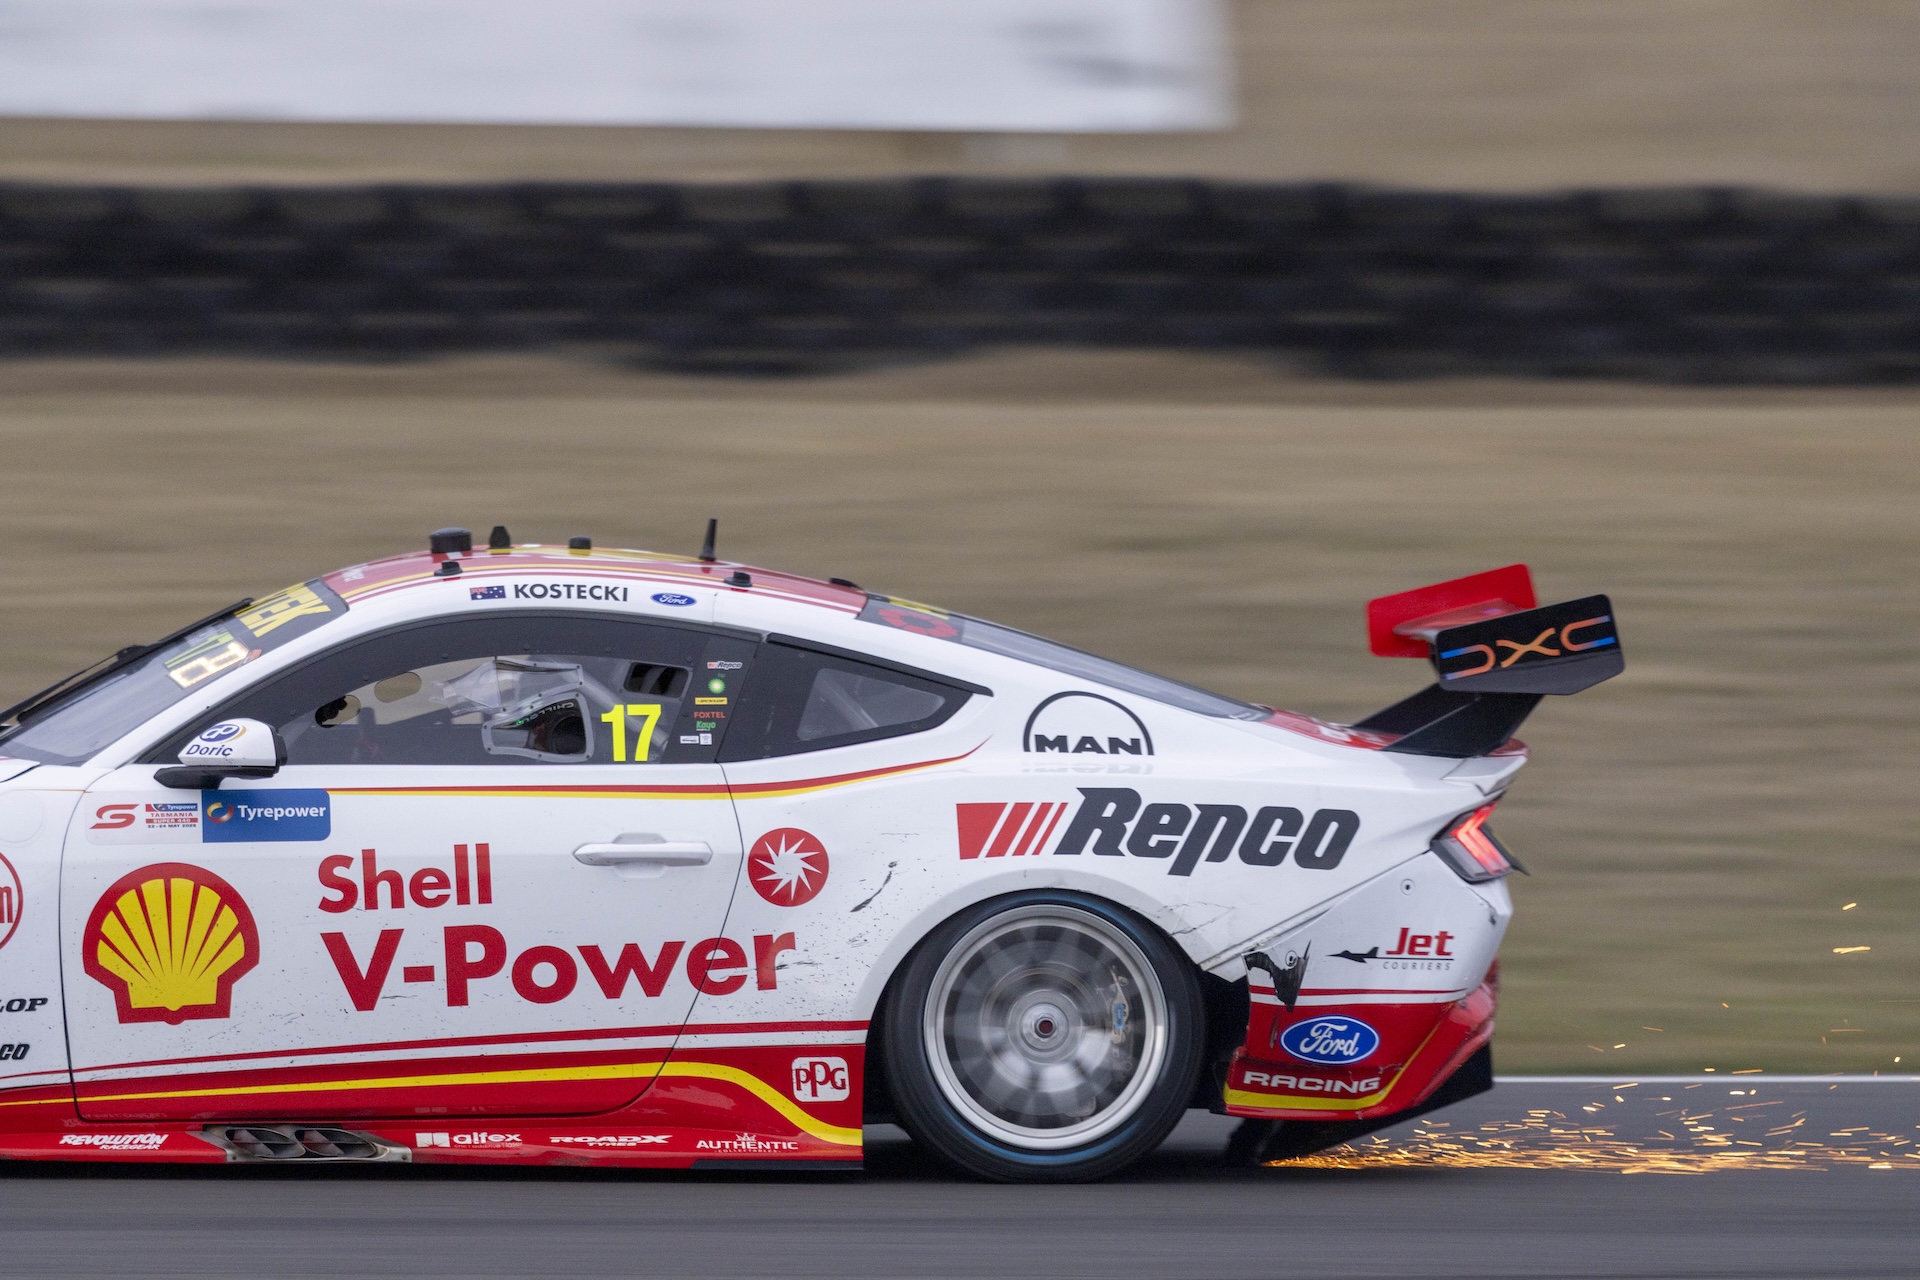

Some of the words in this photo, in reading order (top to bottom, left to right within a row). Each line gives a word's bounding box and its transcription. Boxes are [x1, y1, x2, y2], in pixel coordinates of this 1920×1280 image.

[514, 584, 628, 602] KOSTECKI
[658, 593, 688, 605] Ford
[1440, 615, 1616, 680] DXC
[601, 704, 662, 762] 17
[696, 721, 716, 731] Kayo
[186, 744, 233, 757] Doric
[1034, 734, 1142, 756] MAN
[237, 805, 327, 821] Tyrepower
[1053, 788, 1360, 876] Repco
[318, 843, 493, 913] Shell
[1386, 927, 1454, 956] Jet
[320, 925, 797, 1012] V-Power
[1383, 961, 1451, 971] COURIERS
[1300, 1022, 1360, 1056] Ford
[1243, 1070, 1381, 1094] RACING
[59, 1133, 169, 1146] REVOLUTION
[453, 1131, 522, 1144] alfex
[549, 1135, 673, 1144] ROADX
[696, 1140, 799, 1149] AUTHENTIC
